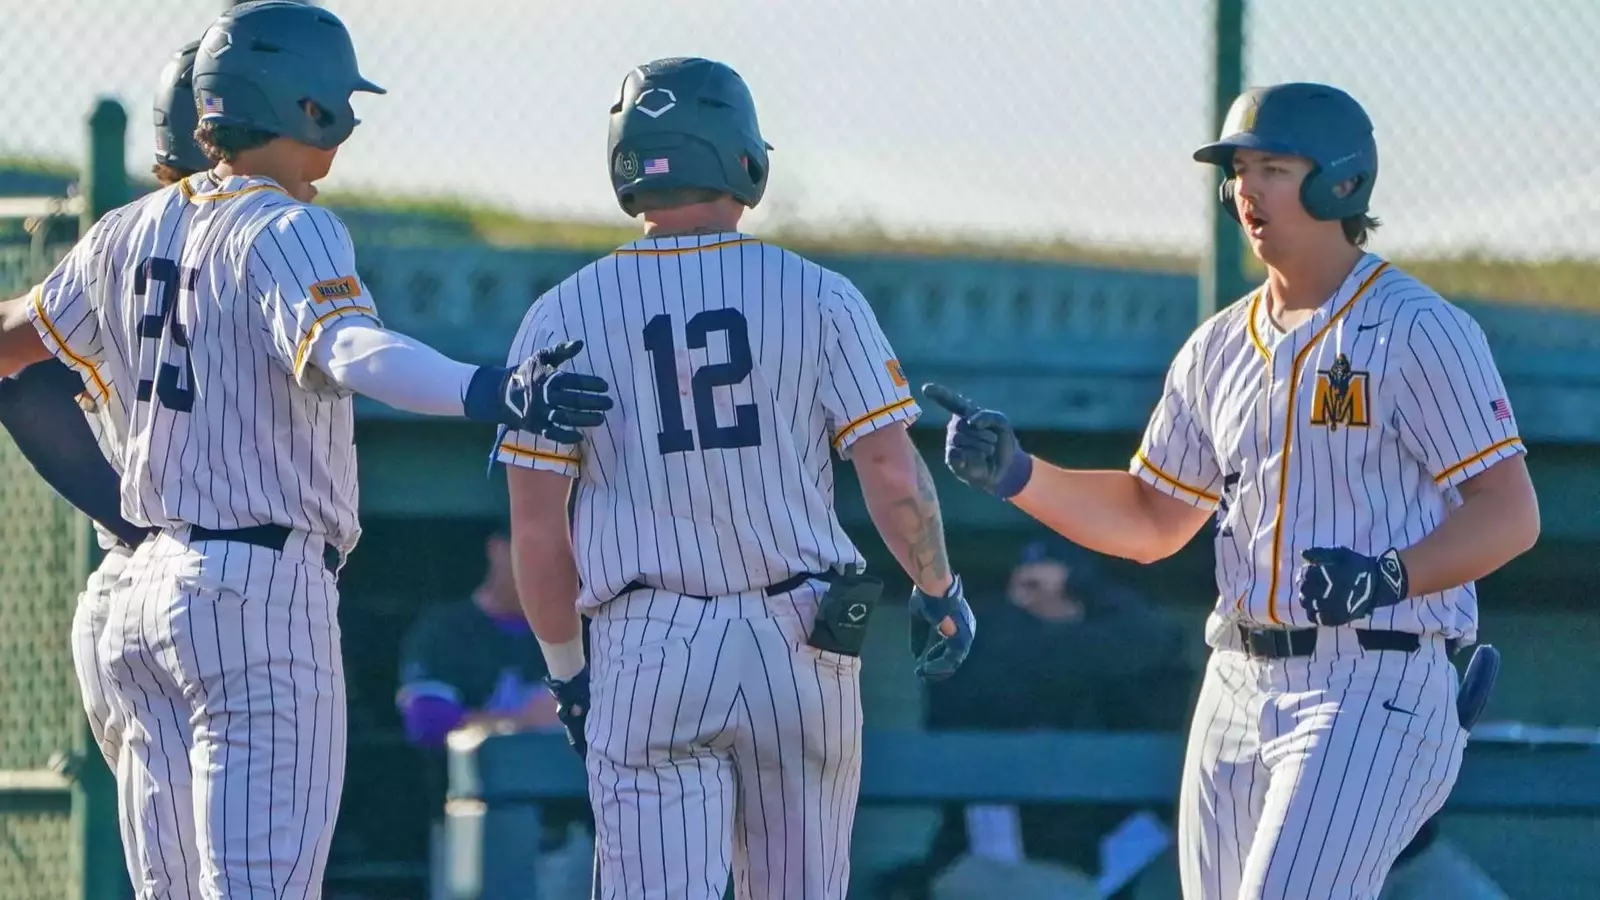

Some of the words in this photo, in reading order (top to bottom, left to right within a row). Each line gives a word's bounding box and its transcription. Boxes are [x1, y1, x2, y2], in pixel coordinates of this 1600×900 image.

[623, 159, 633, 170] 12
[316, 280, 351, 297] VALLEY
[642, 307, 762, 455] 12
